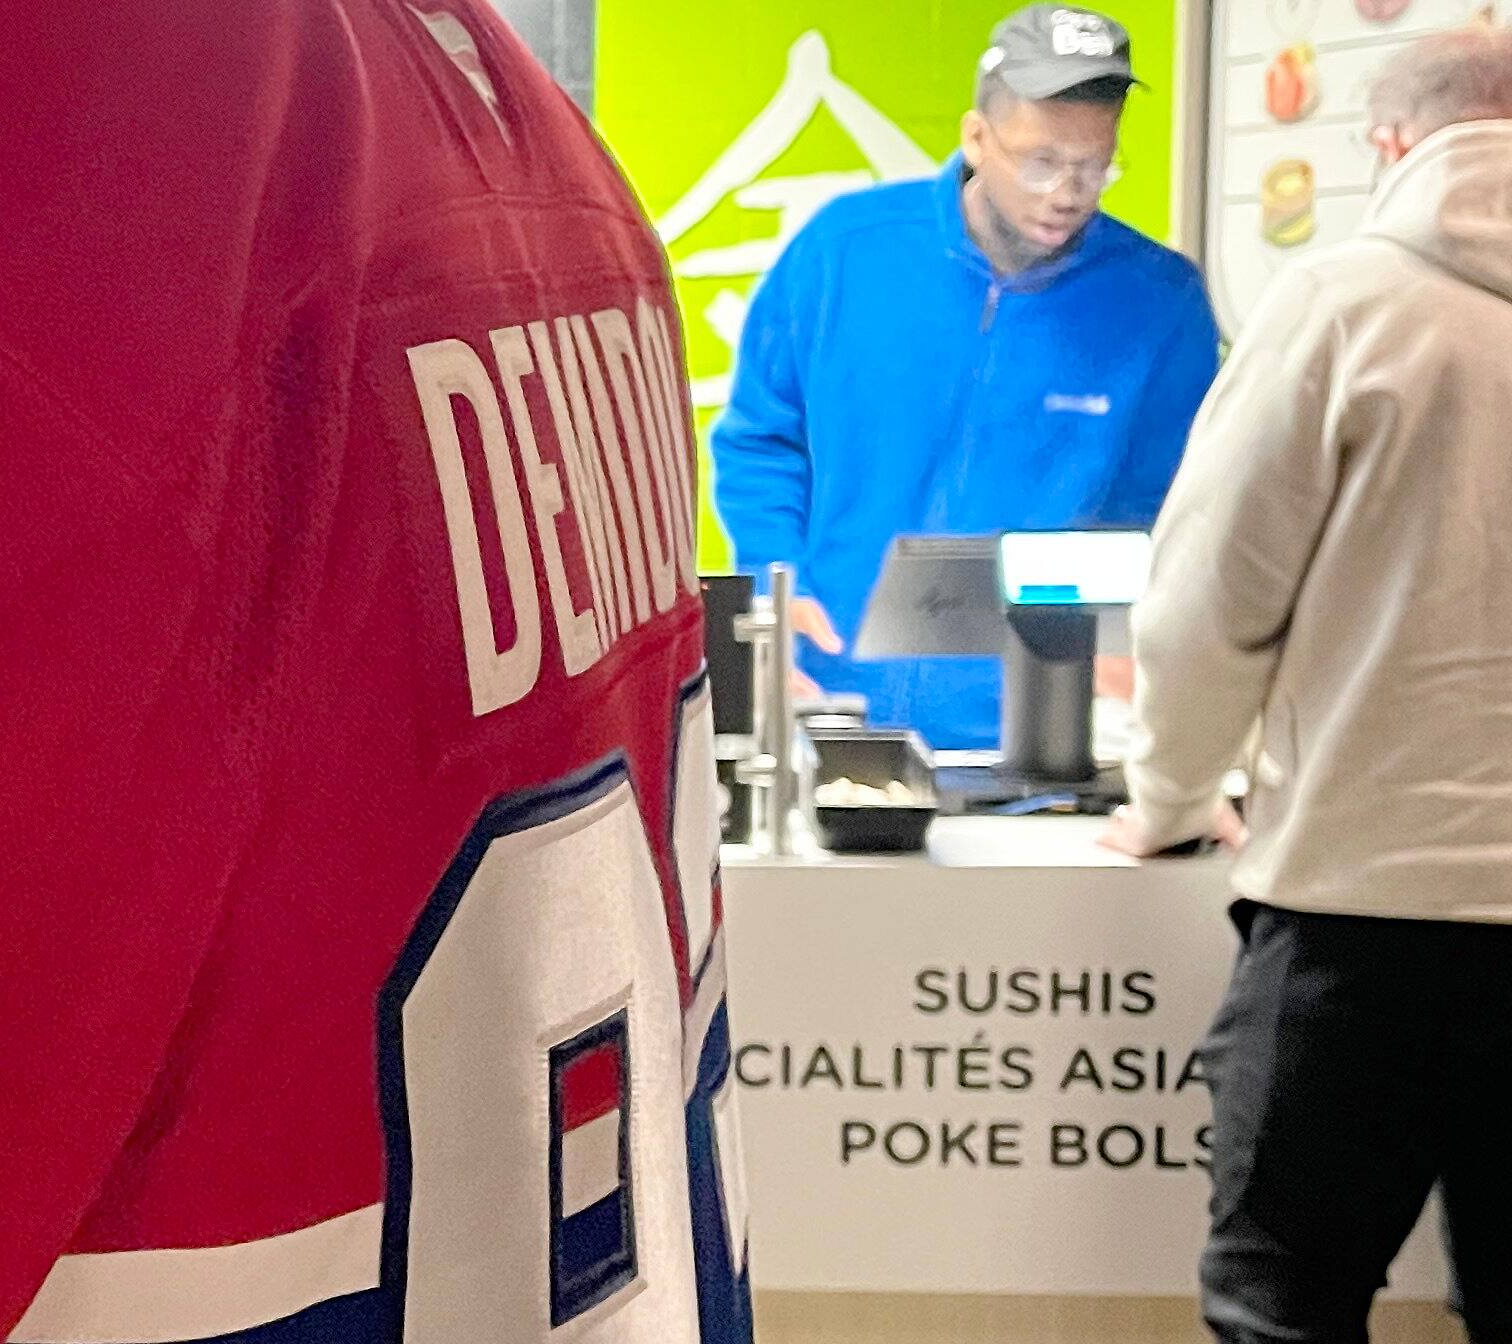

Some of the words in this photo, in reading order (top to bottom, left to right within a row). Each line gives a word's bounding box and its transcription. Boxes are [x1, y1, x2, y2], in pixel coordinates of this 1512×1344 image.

[914, 969, 1157, 1014] SUSHIS
[734, 1030, 1033, 1091] CIALITÉS
[841, 1122, 1022, 1165] POKE
